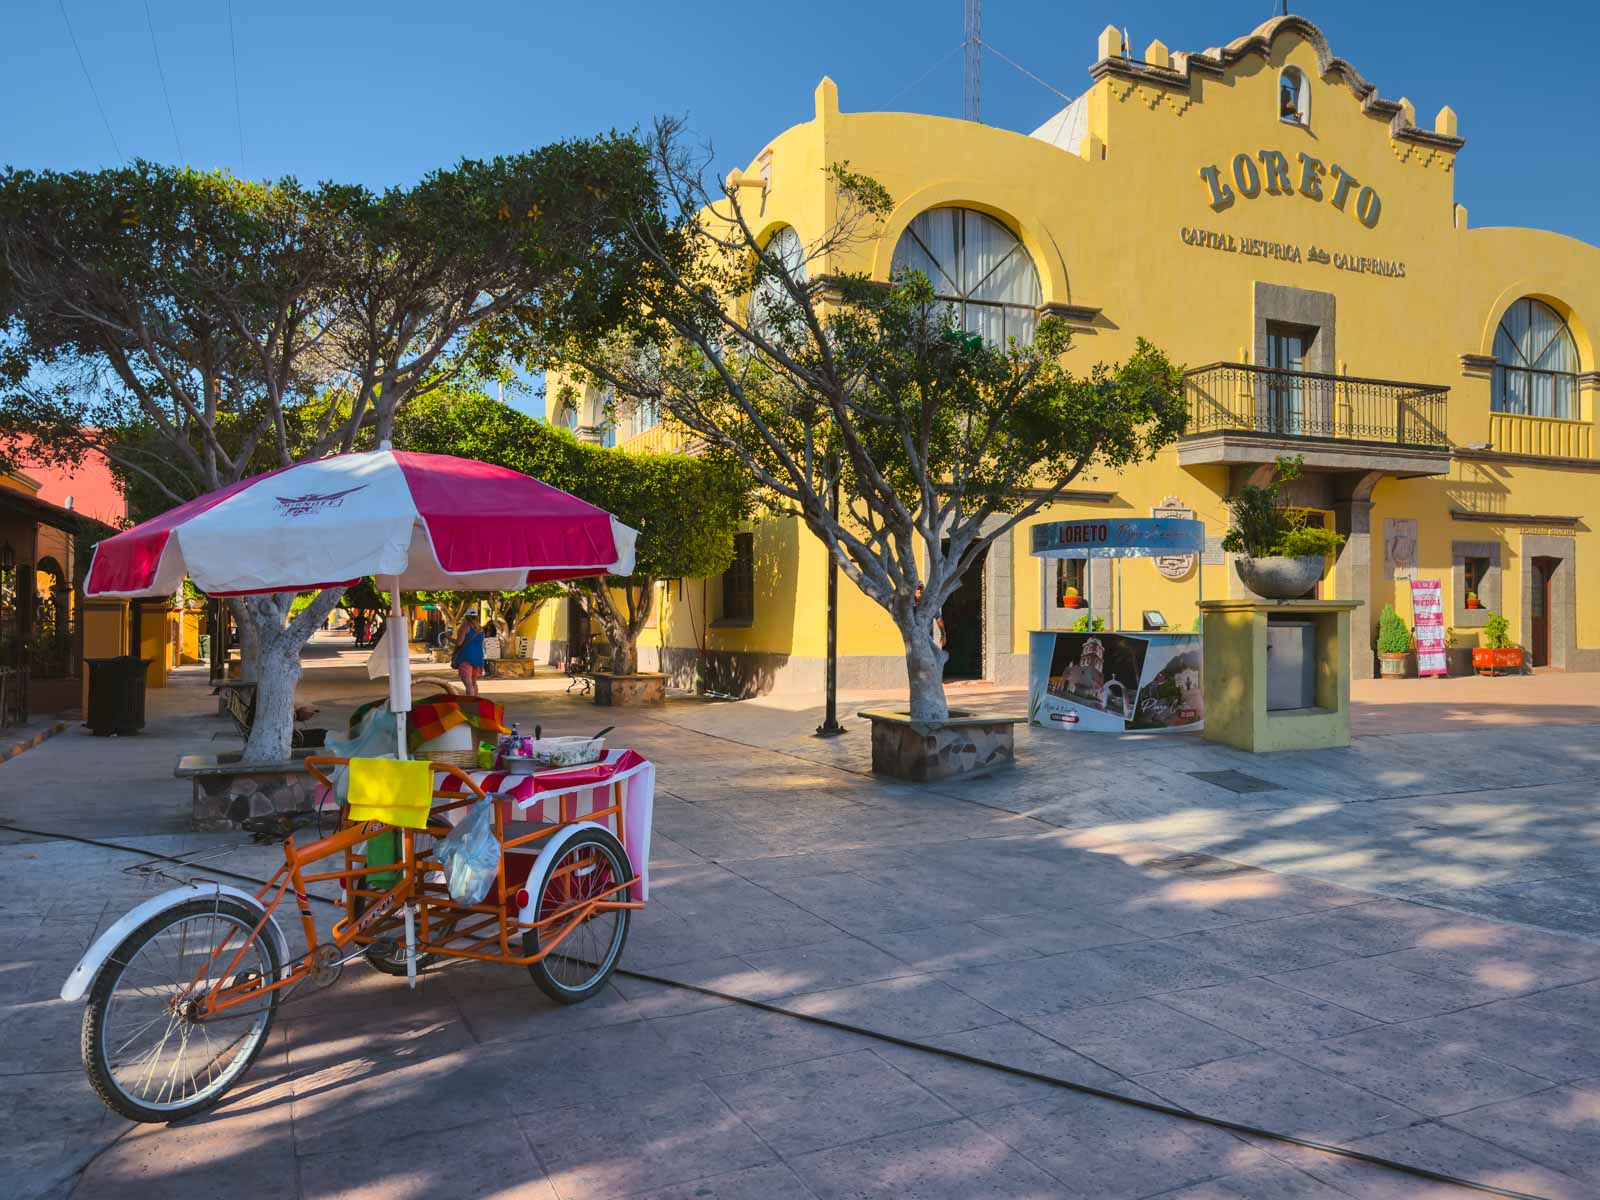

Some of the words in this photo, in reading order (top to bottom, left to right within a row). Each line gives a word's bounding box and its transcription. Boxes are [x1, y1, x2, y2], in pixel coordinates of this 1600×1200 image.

[1199, 150, 1382, 230] LORETO
[1181, 226, 1237, 253] CAPITAL
[1333, 252, 1406, 278] CALIFORNIAS
[1058, 524, 1108, 544] LORETO
